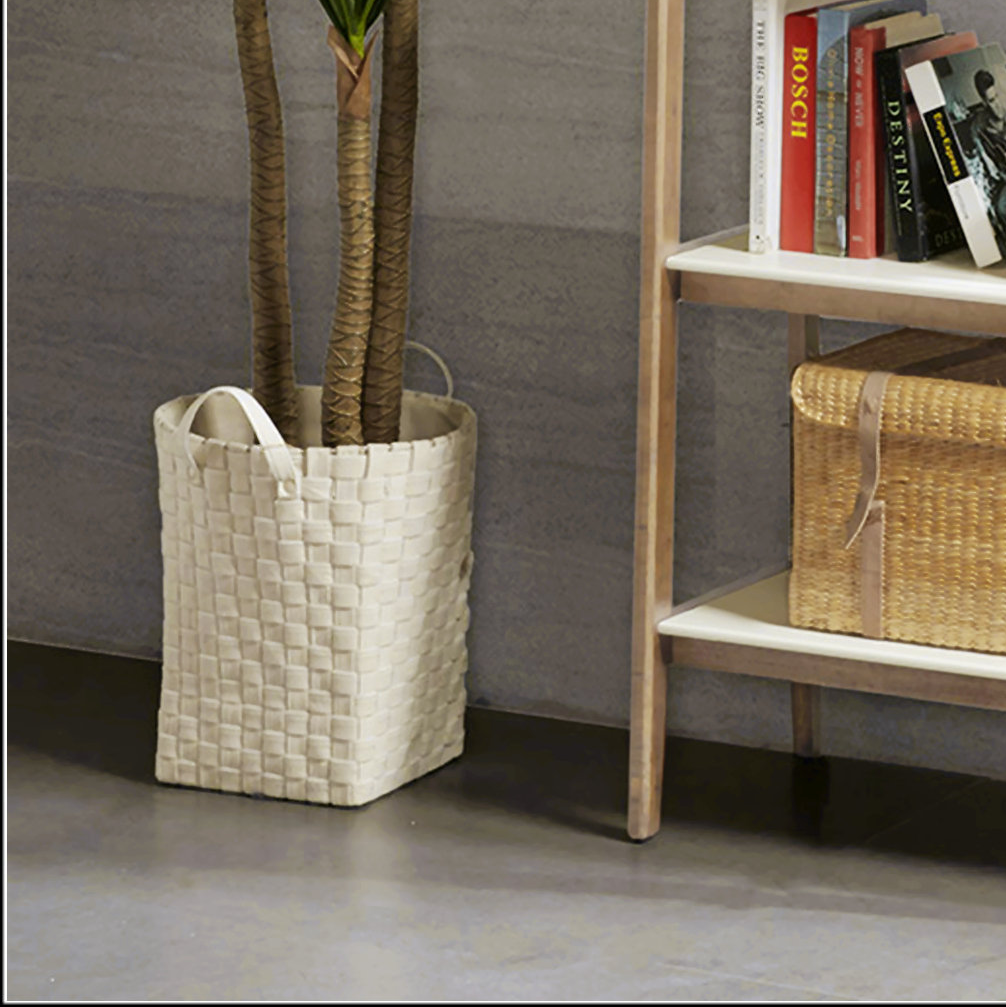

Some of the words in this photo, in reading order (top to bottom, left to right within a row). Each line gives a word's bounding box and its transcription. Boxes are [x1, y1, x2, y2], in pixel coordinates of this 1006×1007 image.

[756, 20, 766, 48] THE
[755, 85, 766, 128] SHOW
[790, 46, 808, 138] BOSCH
[887, 99, 914, 213] DESTINY
